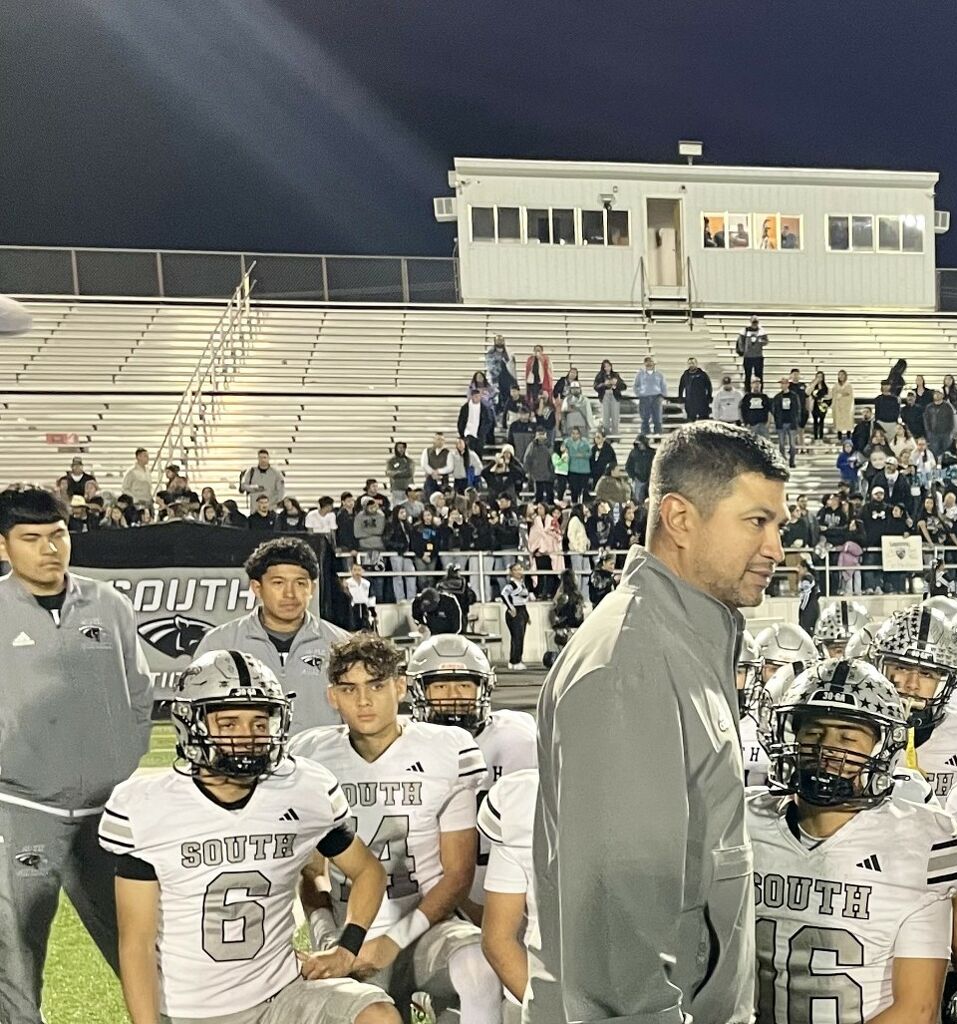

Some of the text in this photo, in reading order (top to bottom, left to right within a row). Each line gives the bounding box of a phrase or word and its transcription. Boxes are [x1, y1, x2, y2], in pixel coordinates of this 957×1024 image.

[342, 782, 422, 807] OUTH
[181, 833, 297, 869] SOUTH
[201, 870, 272, 963] 6
